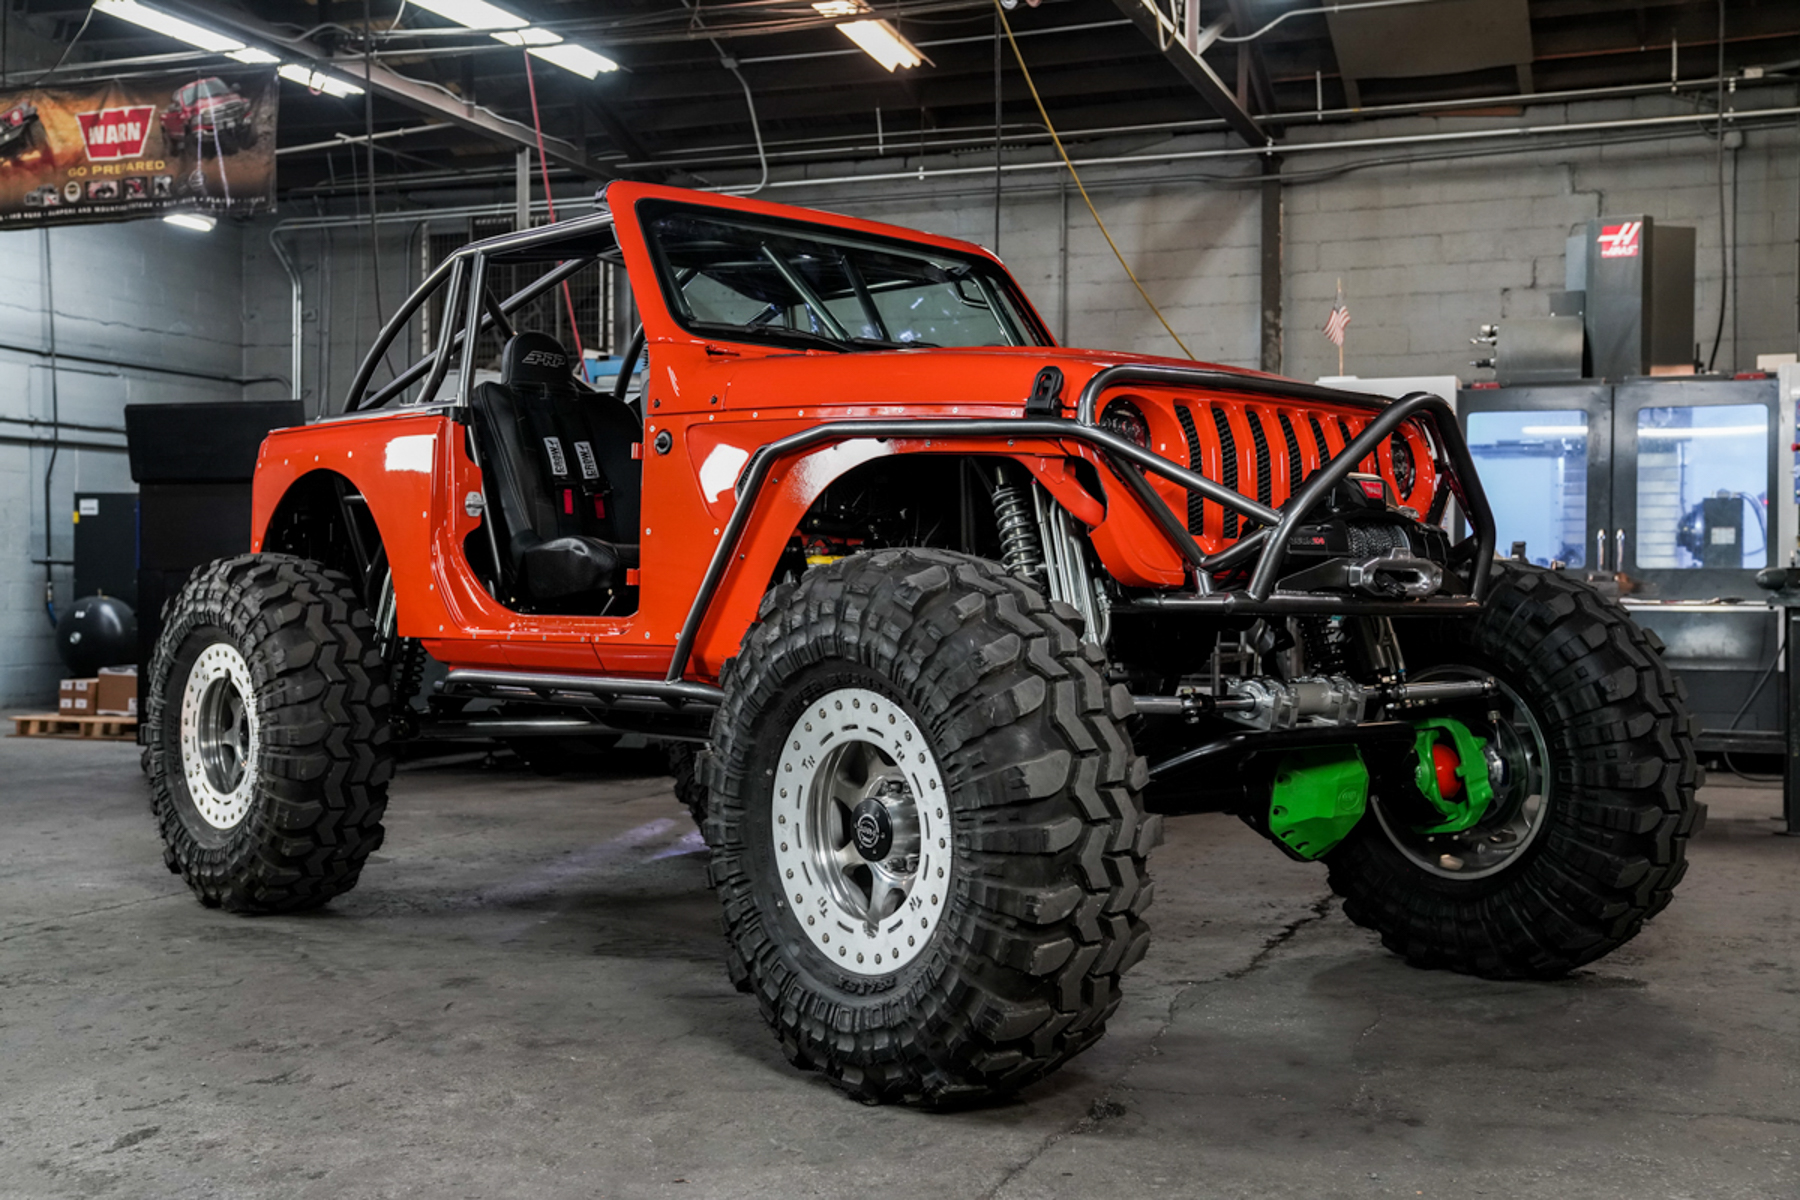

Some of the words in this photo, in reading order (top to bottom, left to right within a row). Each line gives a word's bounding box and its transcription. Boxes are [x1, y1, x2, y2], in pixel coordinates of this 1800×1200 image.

[88, 122, 141, 145] WARN
[67, 166, 87, 177] GO
[92, 160, 166, 176] PREARED
[579, 451, 594, 477] CROW
